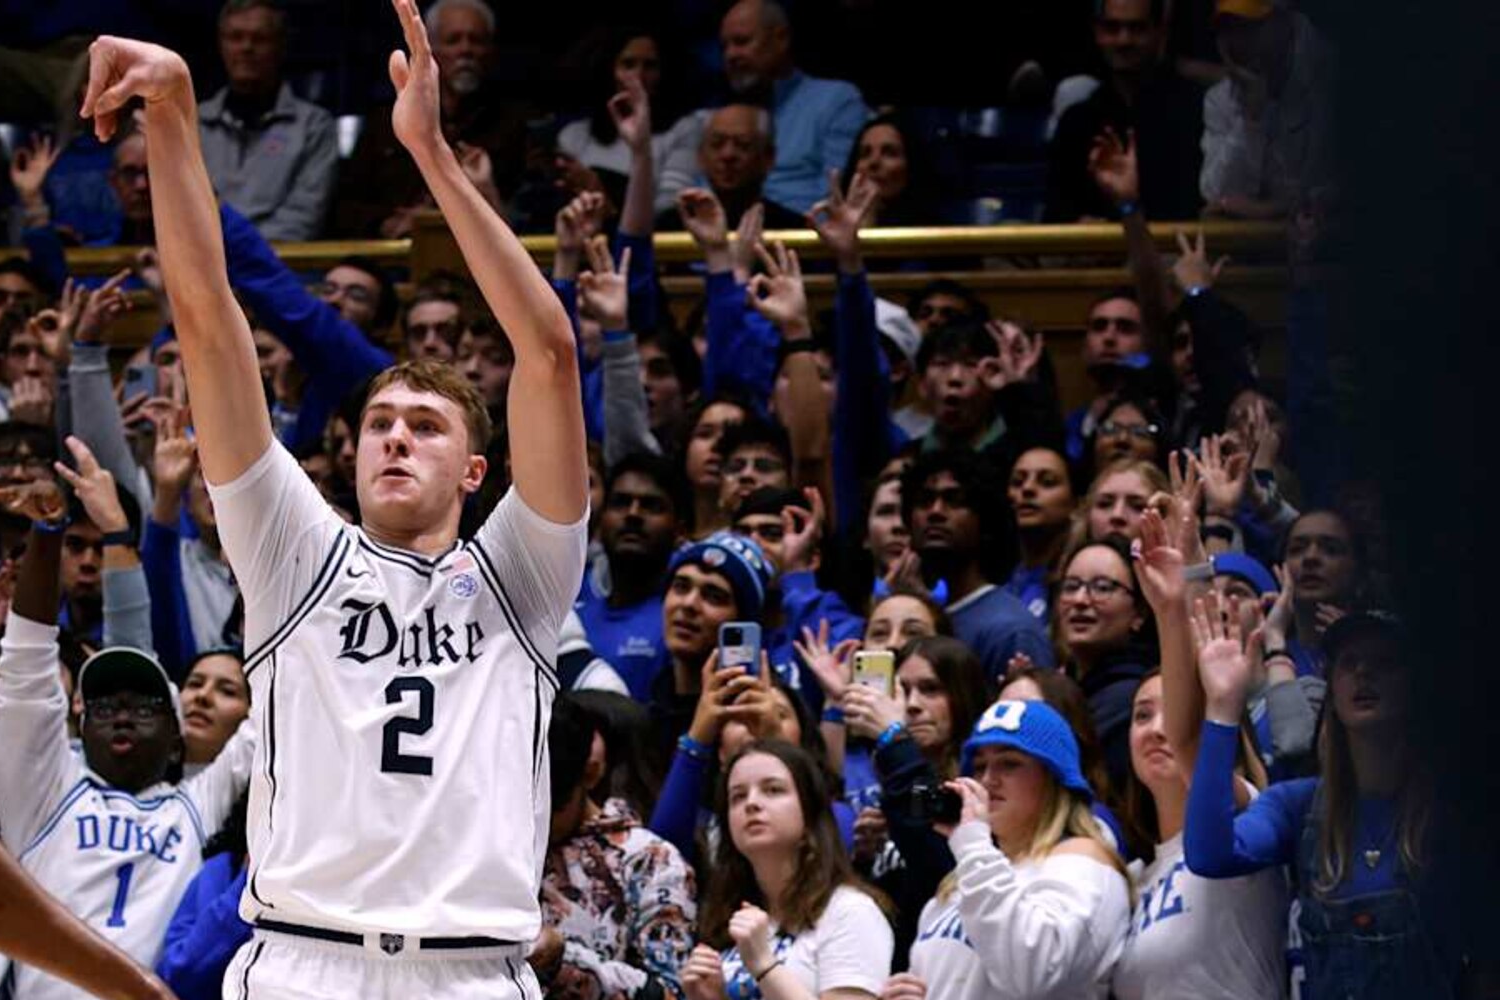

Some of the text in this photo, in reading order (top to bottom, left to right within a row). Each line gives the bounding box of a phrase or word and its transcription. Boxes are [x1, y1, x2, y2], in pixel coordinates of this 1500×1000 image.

[336, 597, 485, 667] Duke
[380, 676, 435, 776] 2
[76, 814, 182, 865] DUKE
[106, 861, 135, 928] 1
